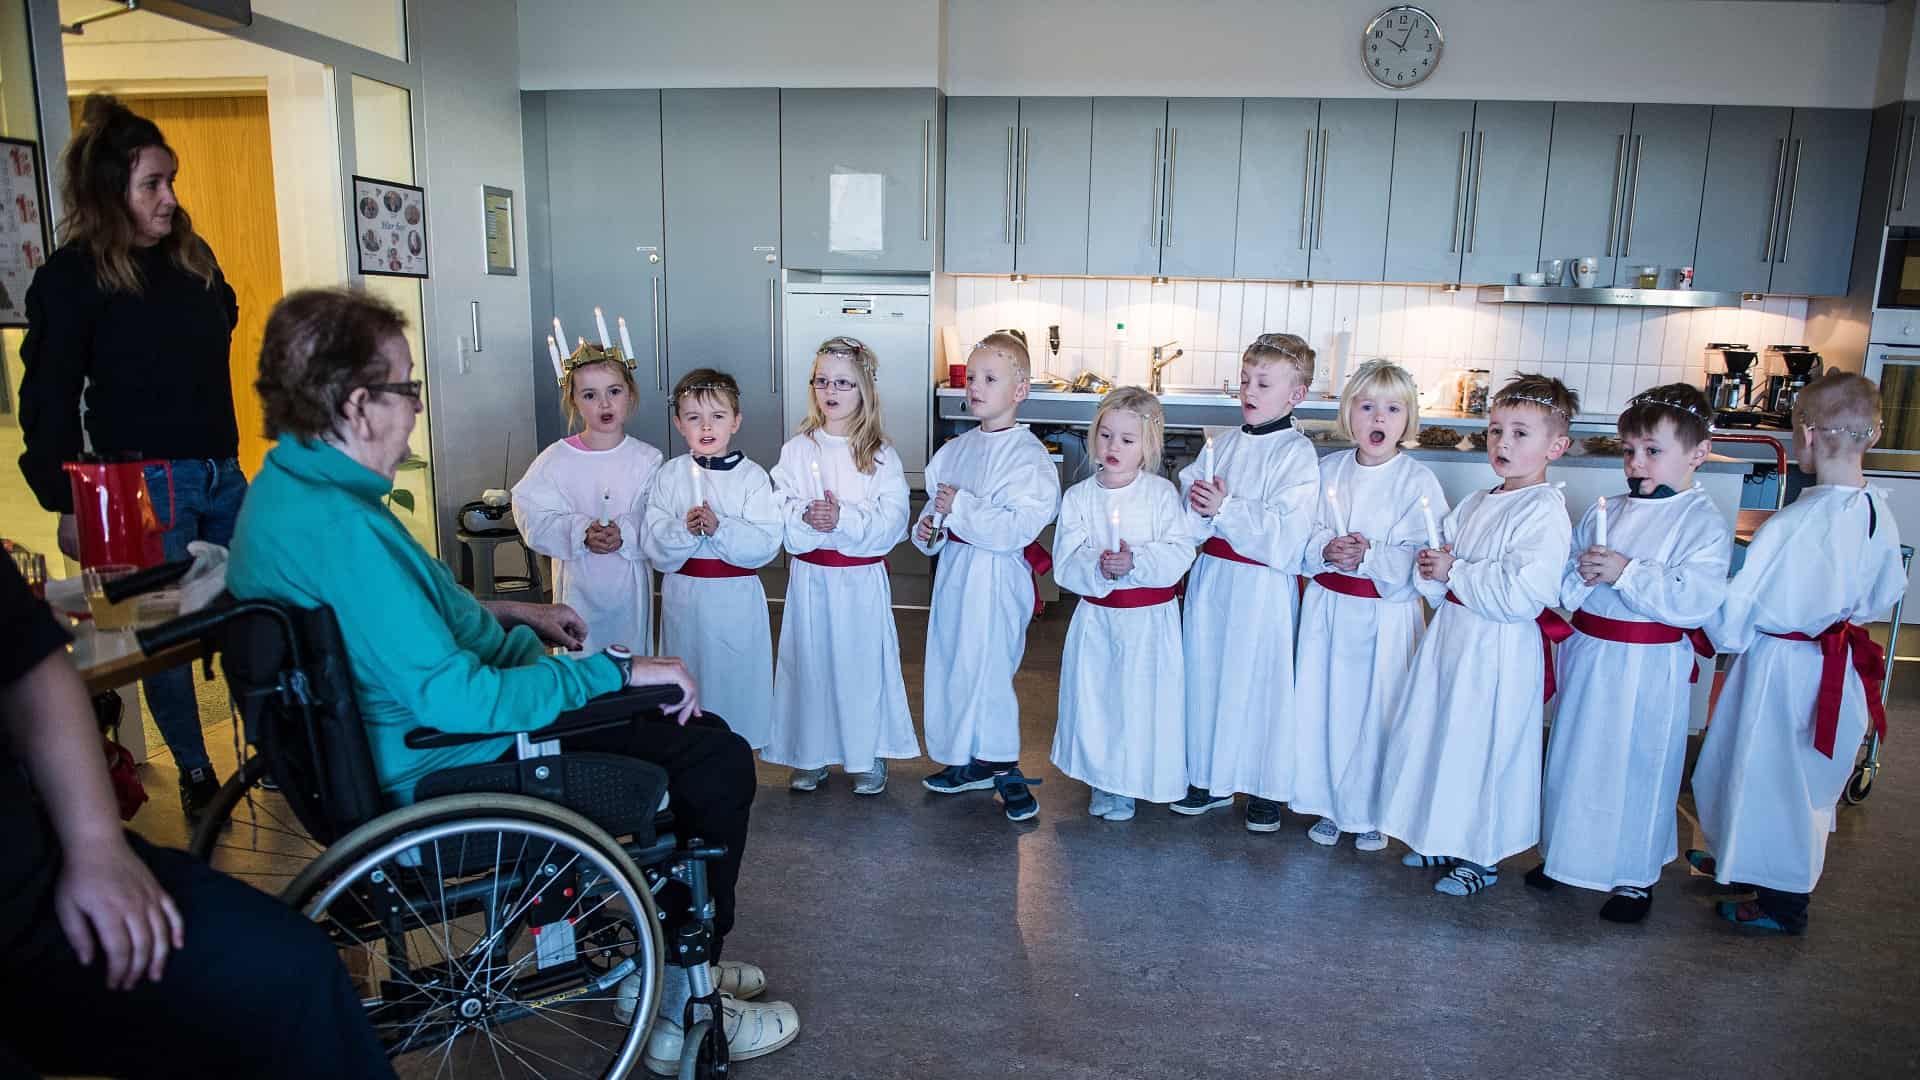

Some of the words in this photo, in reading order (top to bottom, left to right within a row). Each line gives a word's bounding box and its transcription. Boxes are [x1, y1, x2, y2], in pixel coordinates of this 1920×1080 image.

[1386, 19, 1392, 28] 11
[1400, 15, 1408, 24] 12
[1376, 30, 1383, 38] 10
[1424, 29, 1429, 38] 2
[1371, 44, 1377, 52] 9
[1426, 43, 1432, 52] 3
[1375, 58, 1380, 66] 8
[1422, 58, 1428, 66] 4
[1384, 68, 1390, 77] 7
[1397, 72, 1403, 80] 6
[1411, 68, 1417, 77] 5
